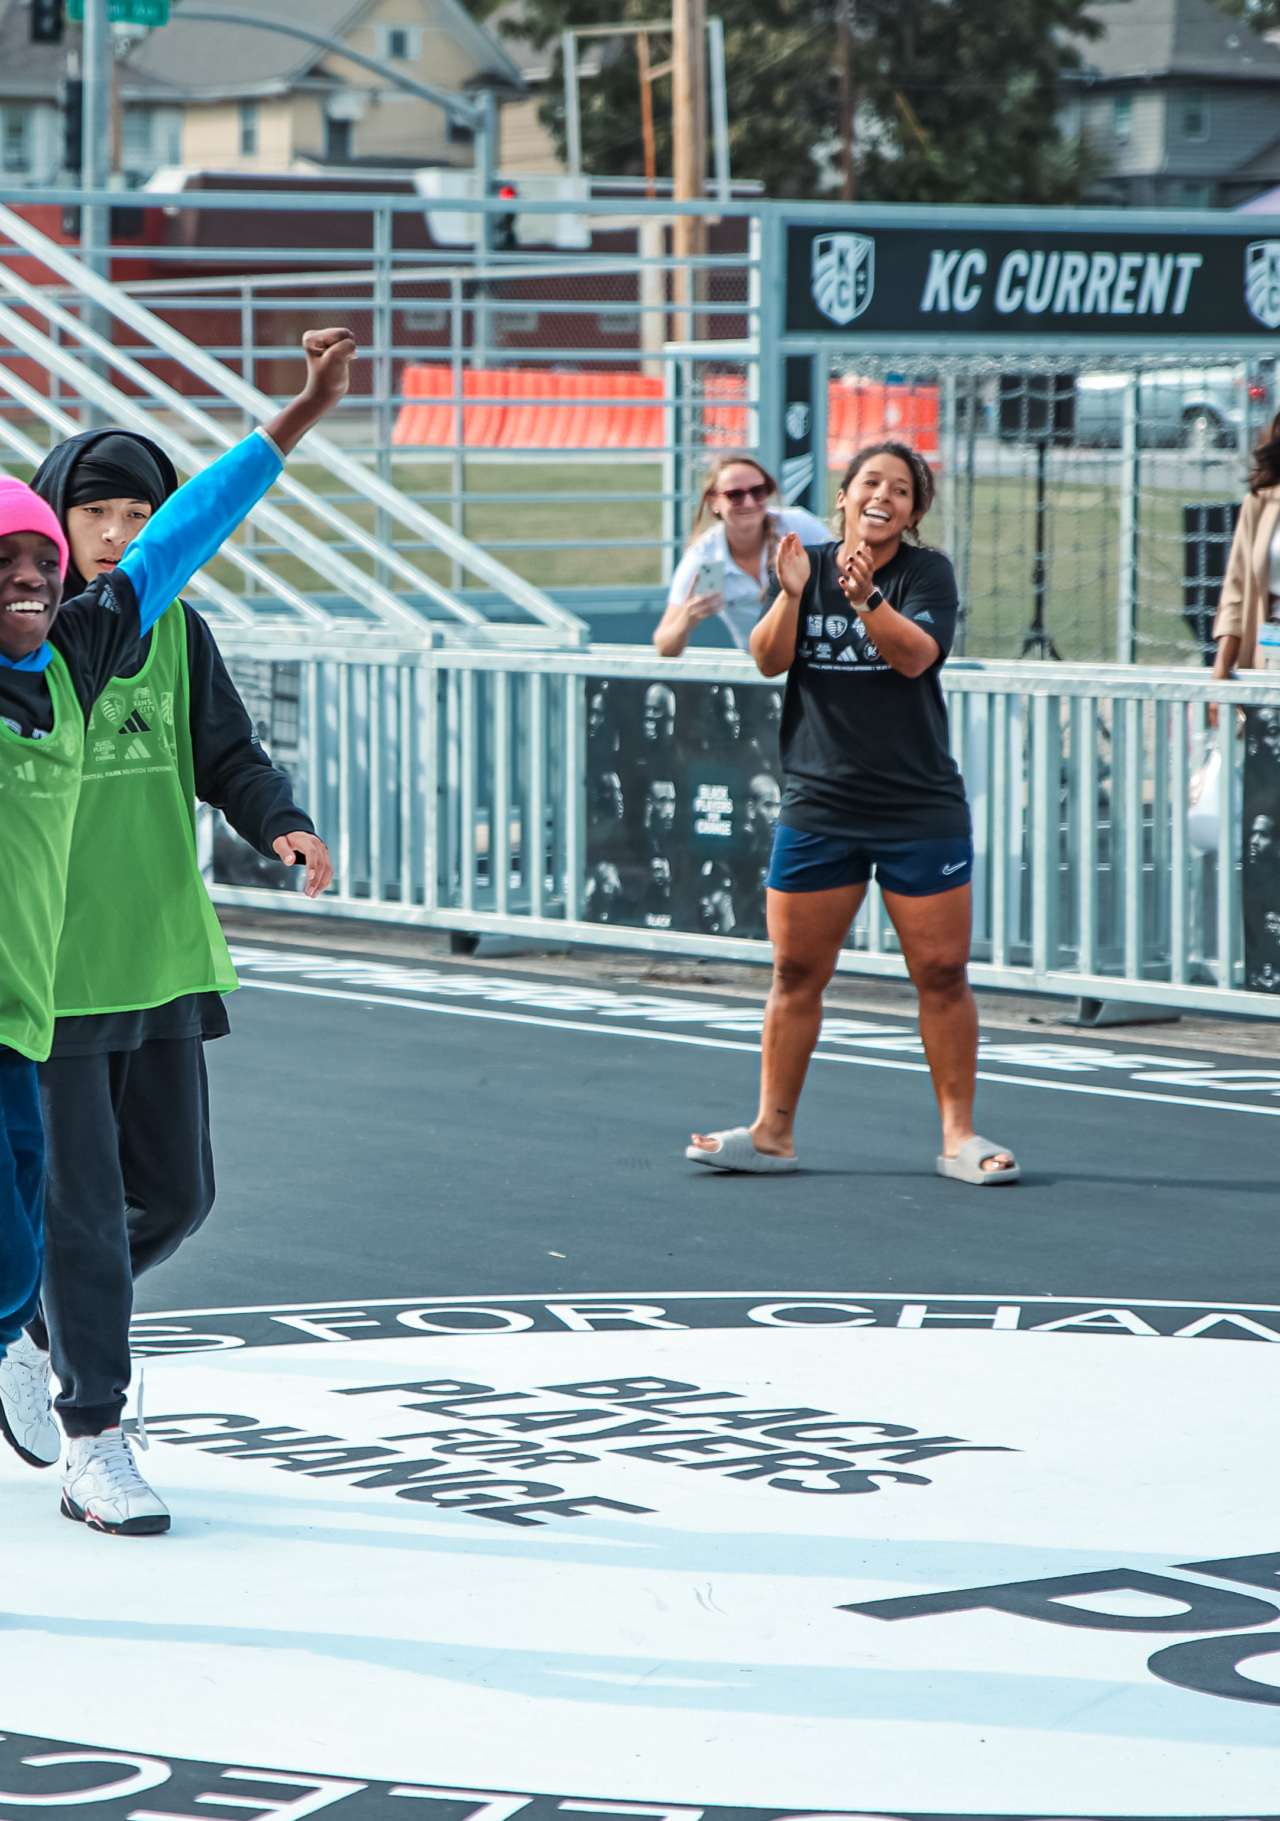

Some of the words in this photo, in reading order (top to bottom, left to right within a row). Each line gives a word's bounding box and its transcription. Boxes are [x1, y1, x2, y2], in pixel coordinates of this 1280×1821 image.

[920, 248, 987, 313] KC
[995, 249, 1203, 315] CURRENT
[269, 1303, 690, 1342] FOR
[327, 1378, 933, 1496] PLAYERS
[376, 1427, 600, 1471] FOR
[533, 1375, 1024, 1466] BLACK
[122, 1411, 659, 1528] CHANGE
